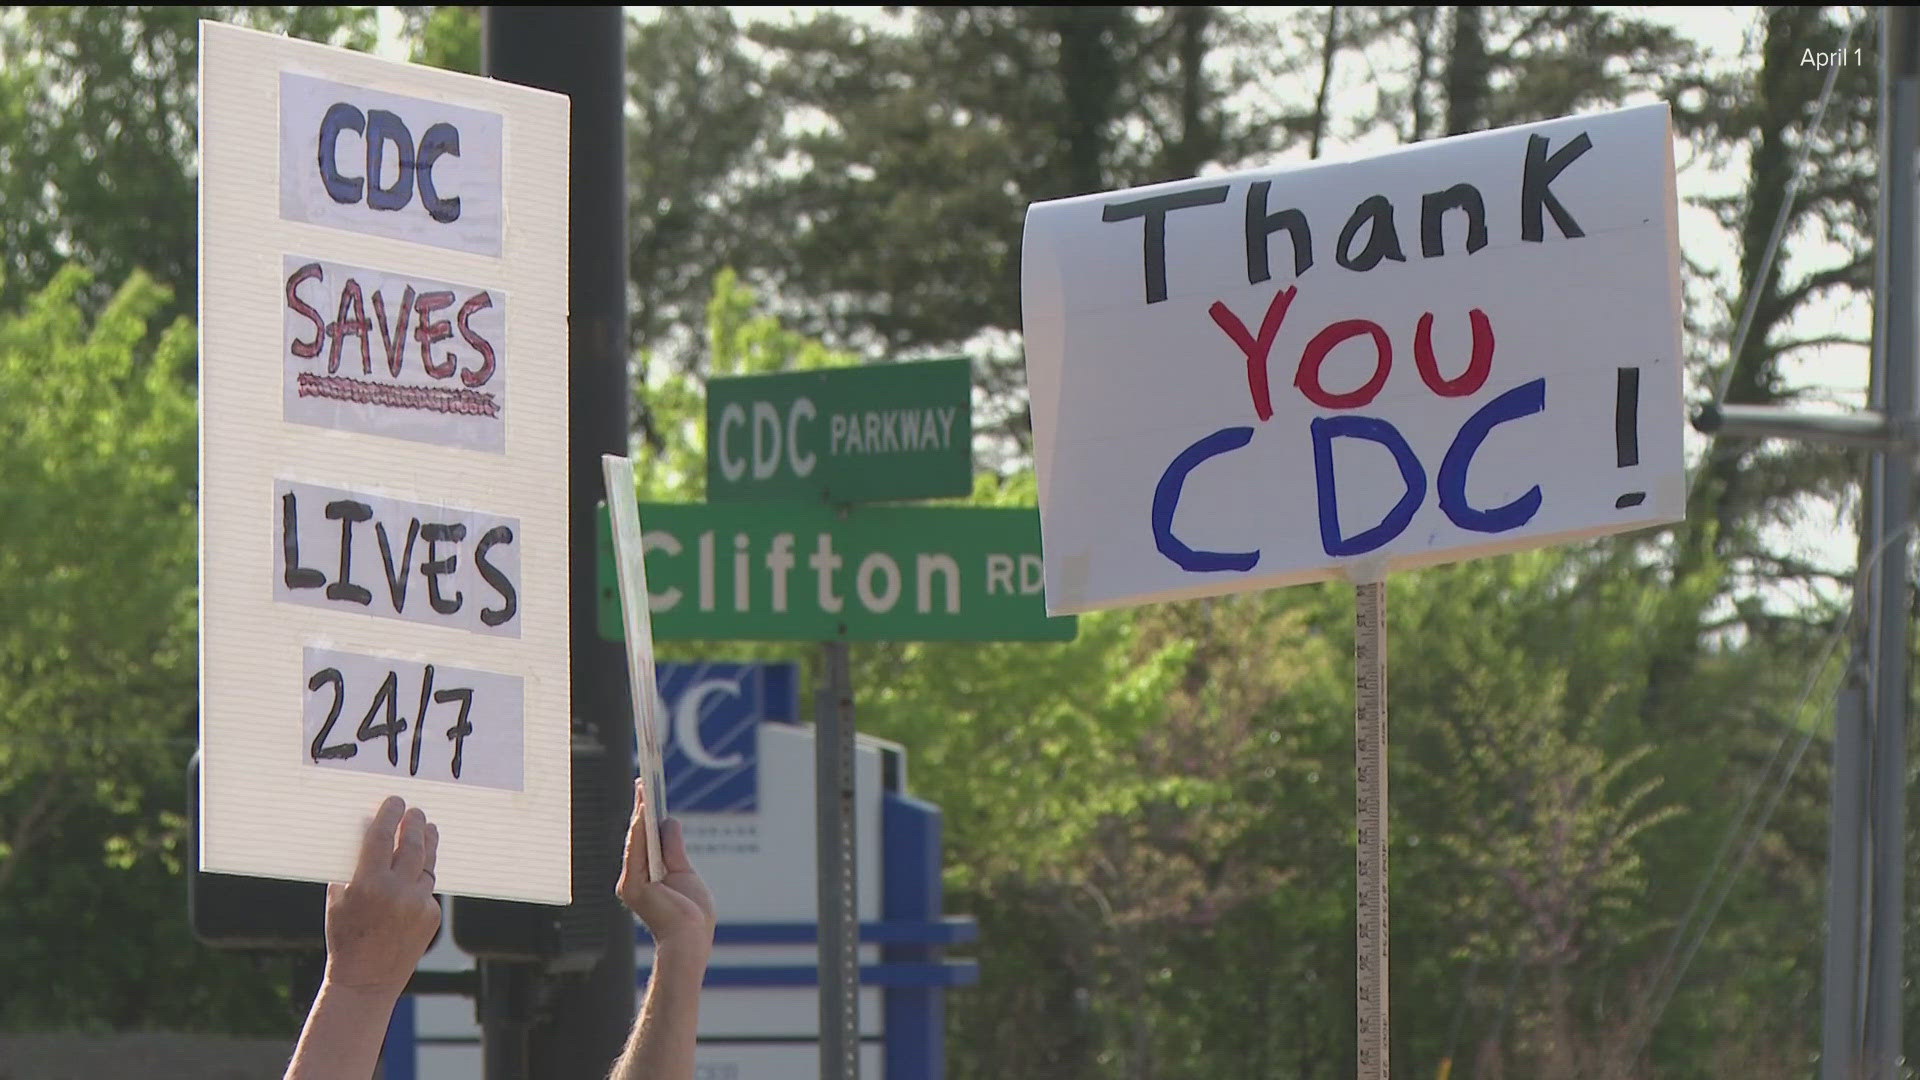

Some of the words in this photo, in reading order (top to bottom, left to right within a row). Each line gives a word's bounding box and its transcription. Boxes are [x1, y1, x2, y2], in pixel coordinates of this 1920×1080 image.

[318, 102, 461, 224] CDC
[286, 262, 496, 388] SAVES
[1208, 285, 1495, 421] YOU
[718, 397, 817, 482] CDC
[830, 406, 956, 457] PARKWAY
[282, 491, 517, 627] LIVES
[643, 530, 961, 614] Clifton
[987, 552, 1044, 595] RD
[309, 664, 474, 779] 24/7
